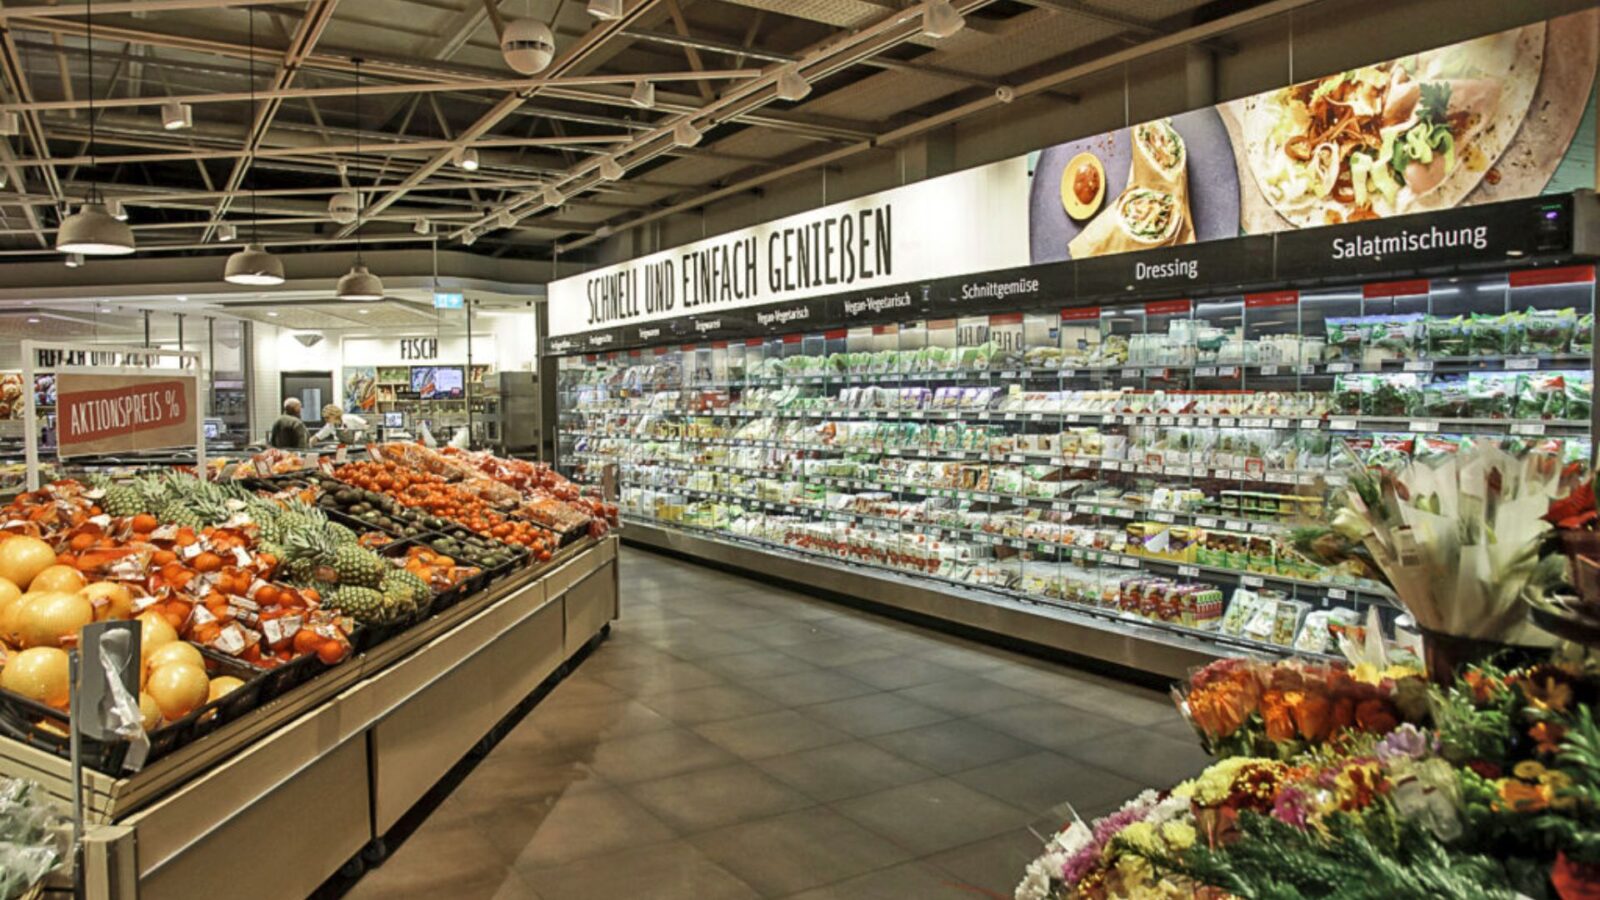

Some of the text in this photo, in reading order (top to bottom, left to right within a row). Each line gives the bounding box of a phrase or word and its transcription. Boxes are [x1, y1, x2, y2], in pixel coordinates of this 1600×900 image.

[1332, 225, 1488, 260] Salatmischung
[587, 268, 640, 325] SCHNELL
[645, 259, 675, 315] UND
[683, 235, 758, 307] EINFACH
[1135, 258, 1199, 280] Dressing
[961, 278, 1039, 300] Schnittgemüse
[401, 338, 438, 360] FISCH
[71, 389, 181, 436] AKTIONSPREIS %
